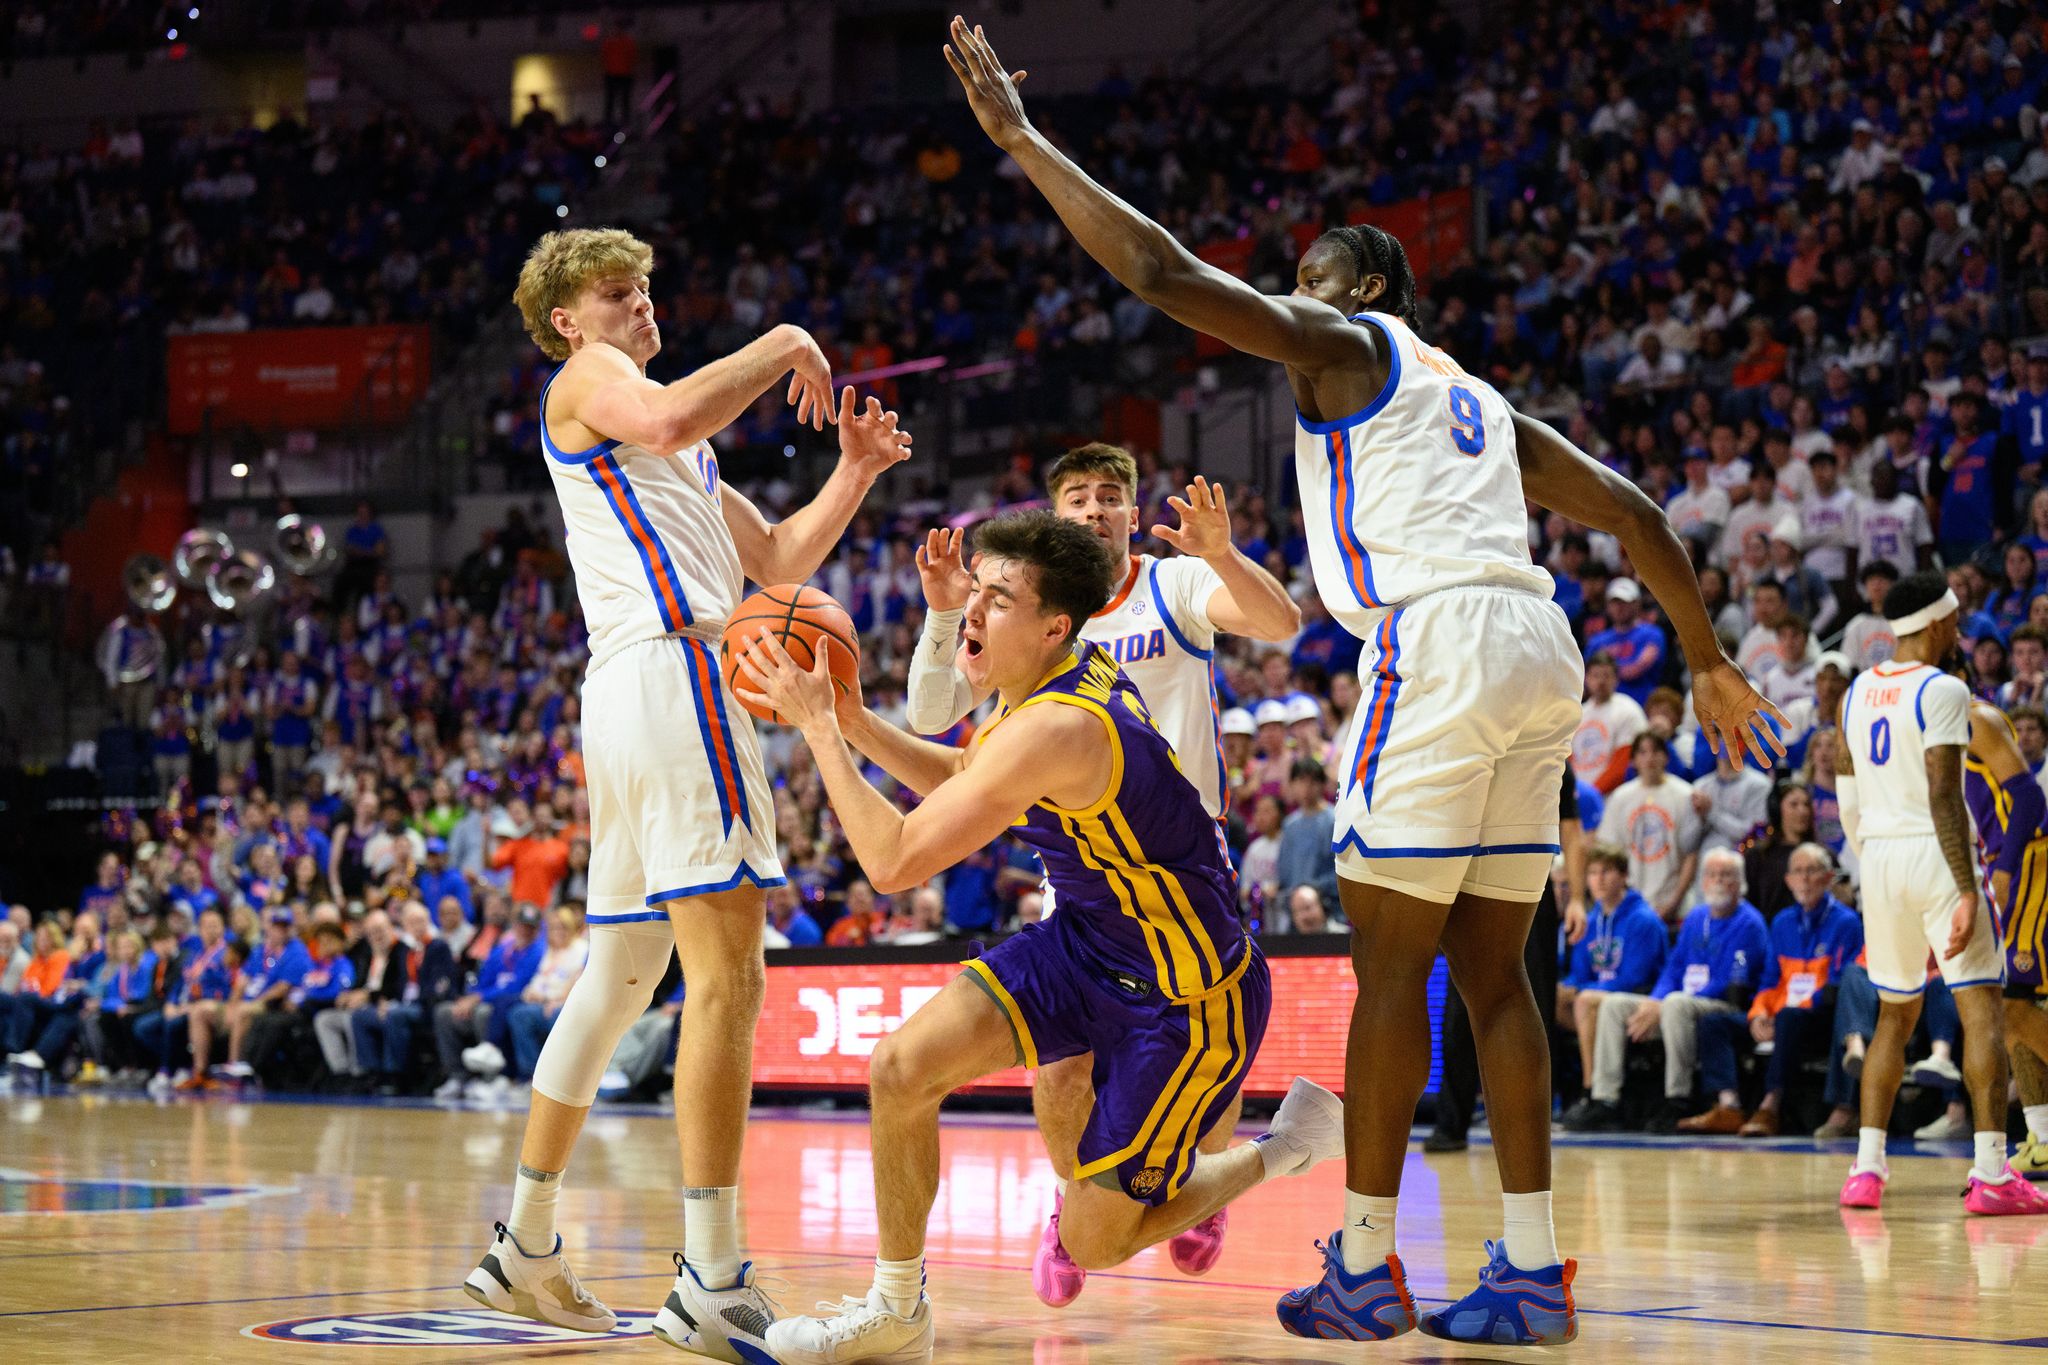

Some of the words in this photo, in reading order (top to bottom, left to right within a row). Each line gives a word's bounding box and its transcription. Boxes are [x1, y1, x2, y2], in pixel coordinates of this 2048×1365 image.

[1448, 383, 1487, 459] 9
[2029, 405, 2045, 447] 1
[1870, 715, 1892, 767] 0
